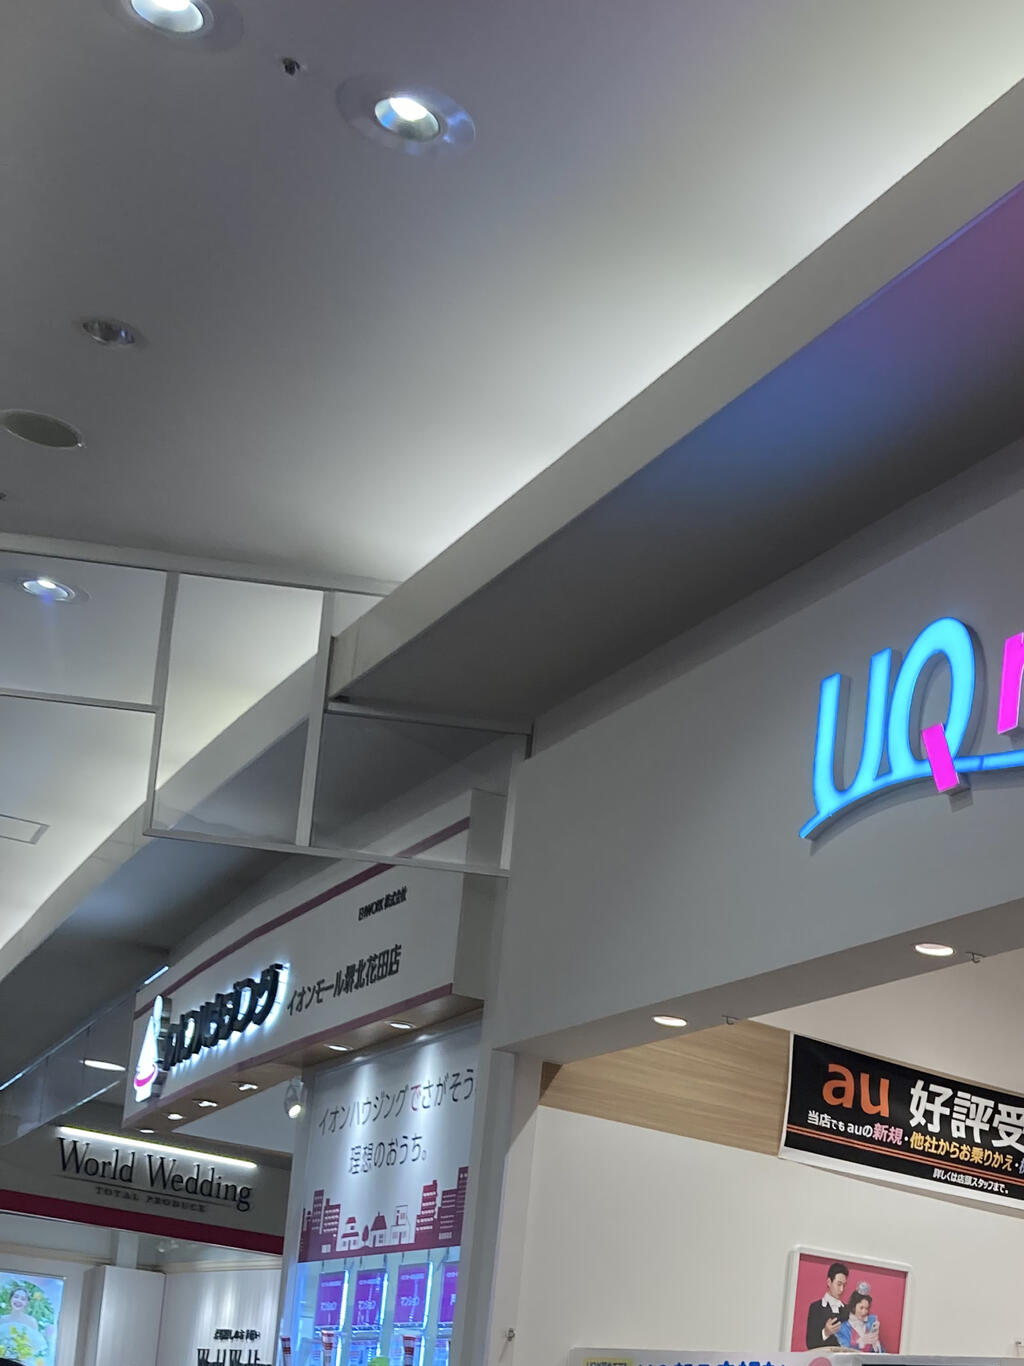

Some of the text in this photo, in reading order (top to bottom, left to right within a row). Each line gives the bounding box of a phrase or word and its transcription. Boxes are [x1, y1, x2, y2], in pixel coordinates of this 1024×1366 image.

[806, 617, 977, 808] UQ
[822, 1063, 890, 1118] au
[57, 1137, 254, 1212] World Wedding
[348, 1134, 429, 1176] 理想のおうち。
[95, 1185, 207, 1213] TOTAL PRODUCE
